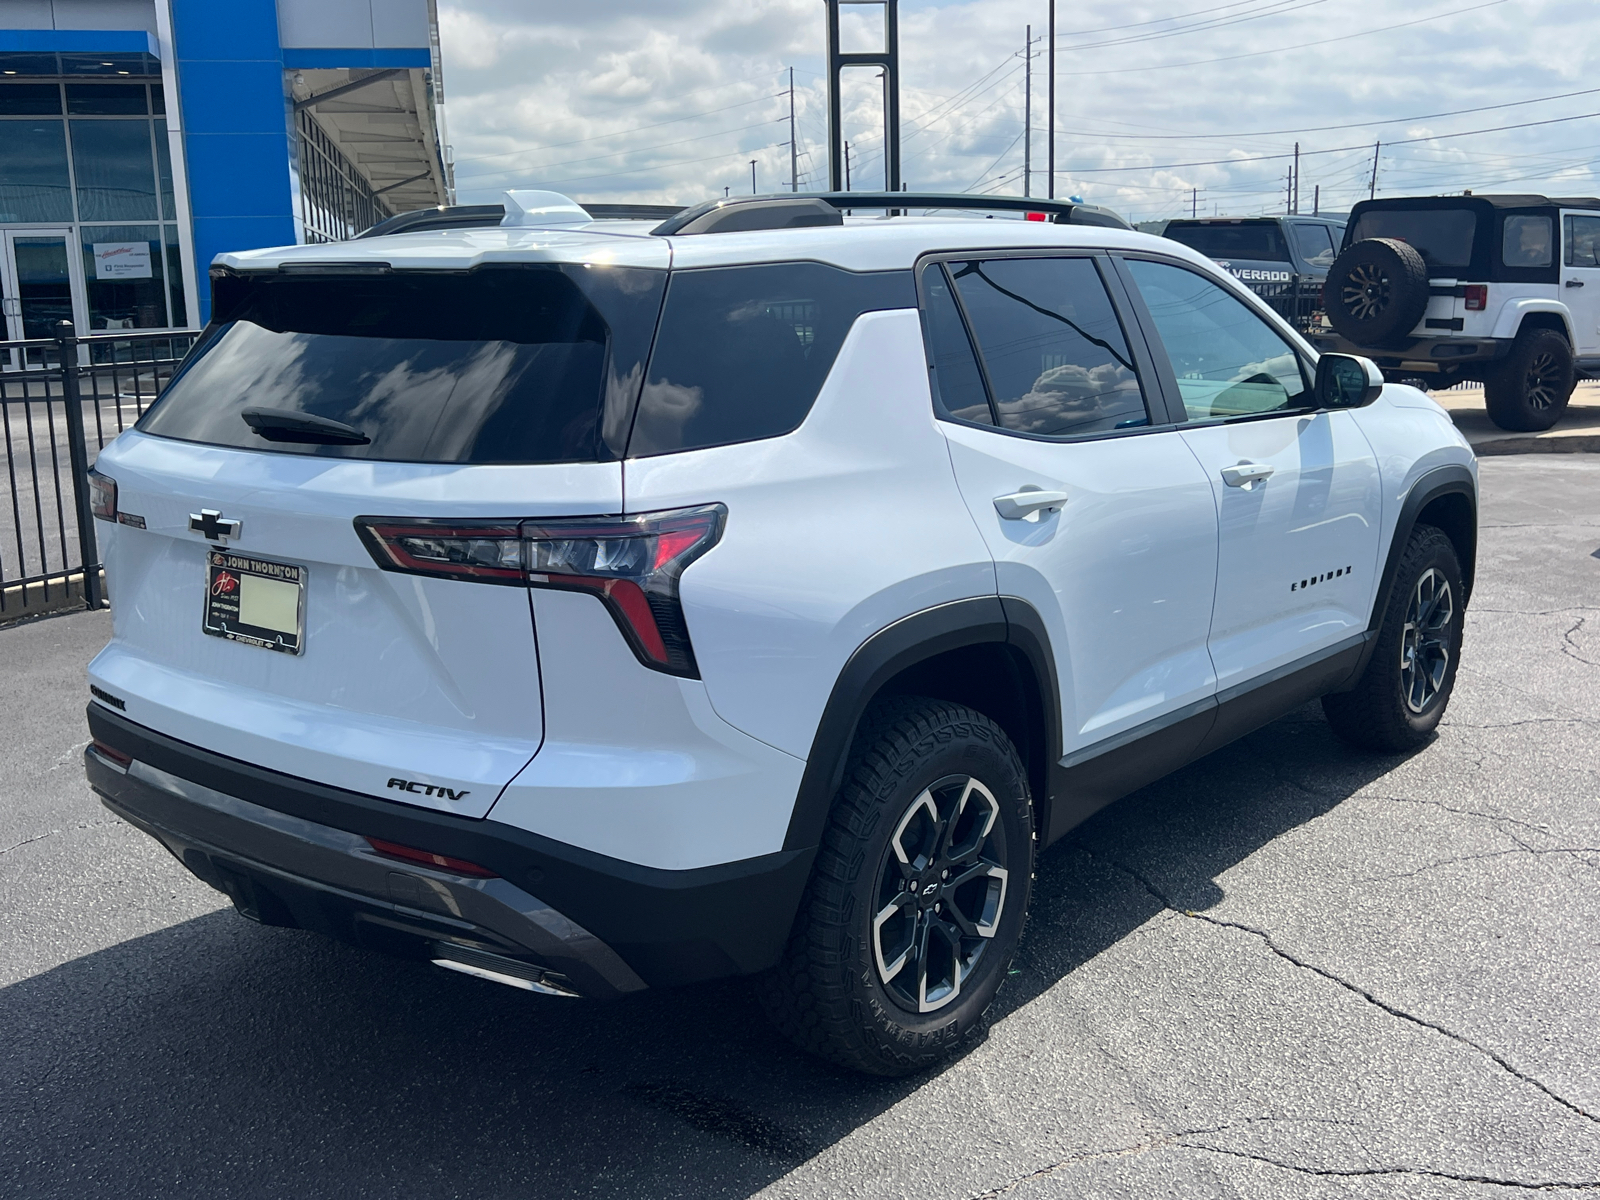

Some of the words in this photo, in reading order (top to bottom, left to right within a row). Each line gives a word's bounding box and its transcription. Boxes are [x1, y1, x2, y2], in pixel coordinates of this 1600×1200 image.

[227, 556, 249, 570] JOHN
[250, 560, 298, 579] THORNTON
[1291, 565, 1352, 592] EQUINOX
[386, 777, 471, 801] ACTIV
